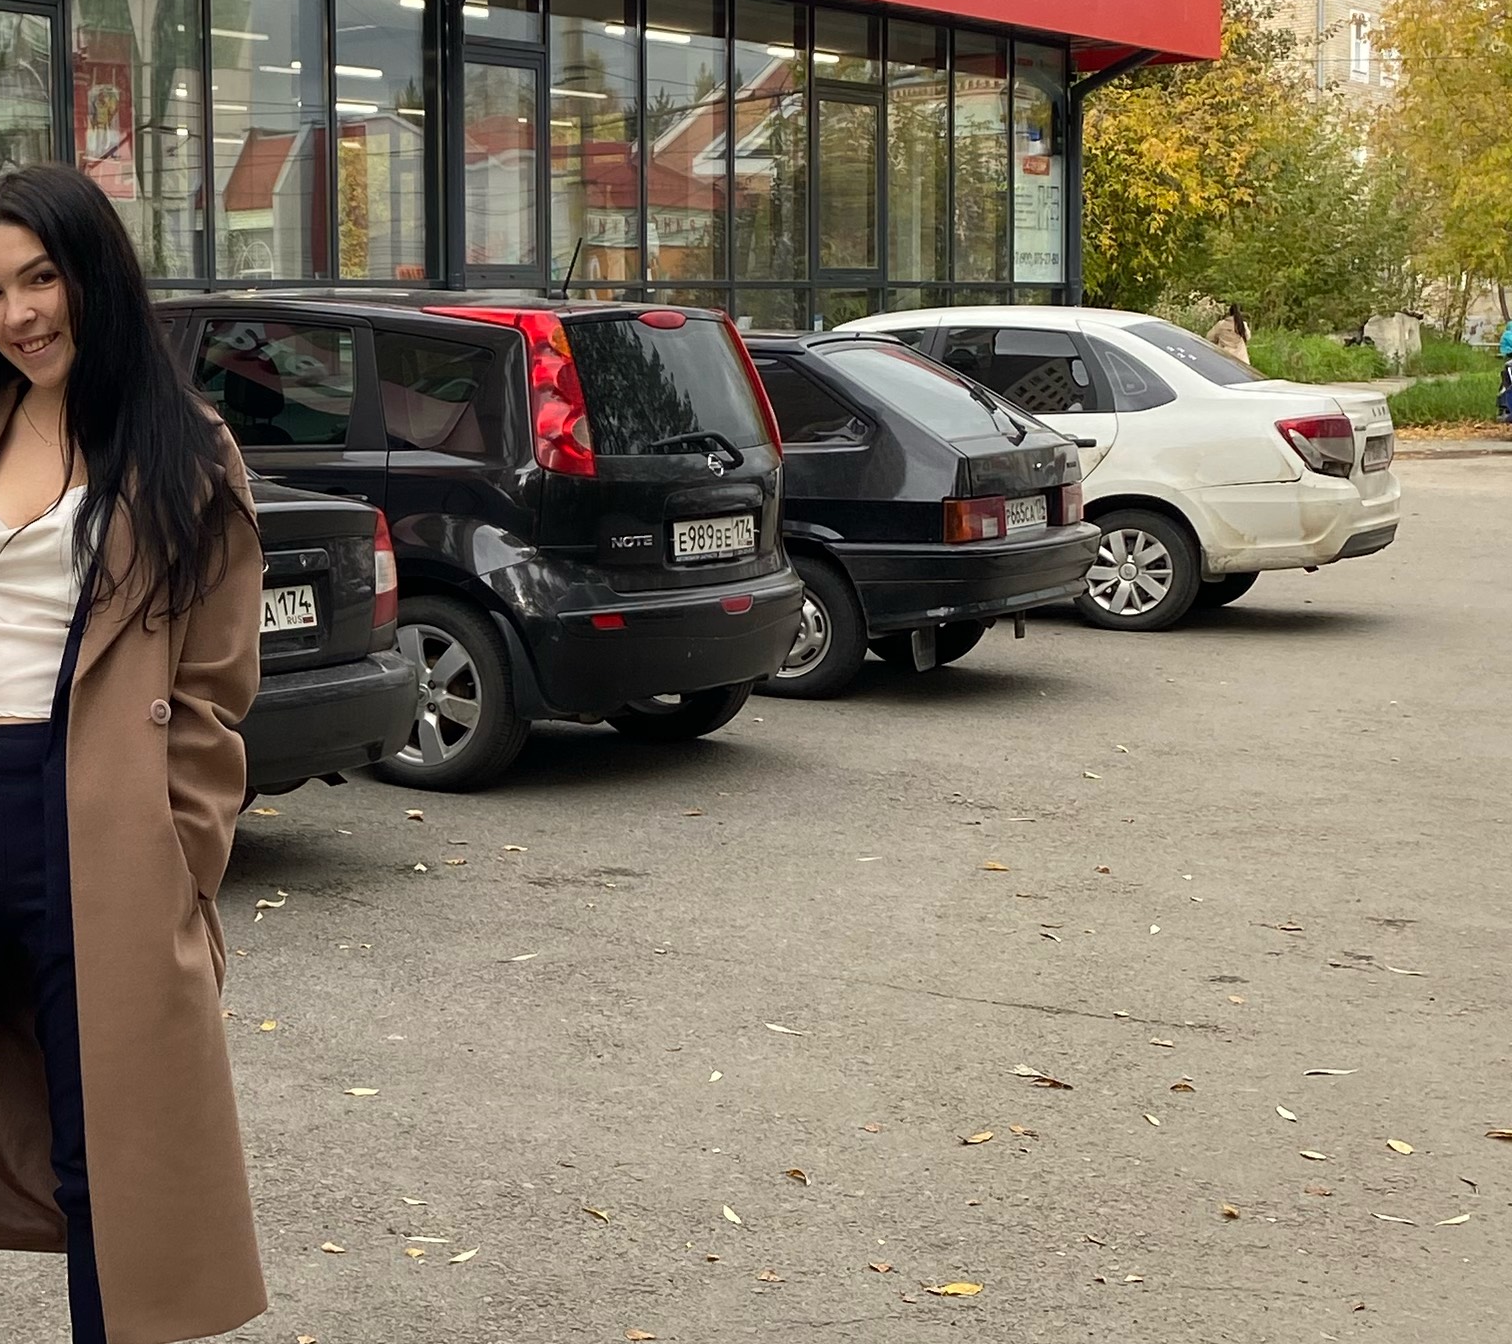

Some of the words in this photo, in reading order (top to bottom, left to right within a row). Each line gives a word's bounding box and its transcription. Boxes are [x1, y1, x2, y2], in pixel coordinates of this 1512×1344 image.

[734, 518, 752, 540] 174
[610, 534, 653, 549] NOTE
[278, 589, 310, 616] 174
[286, 615, 303, 625] RUS
